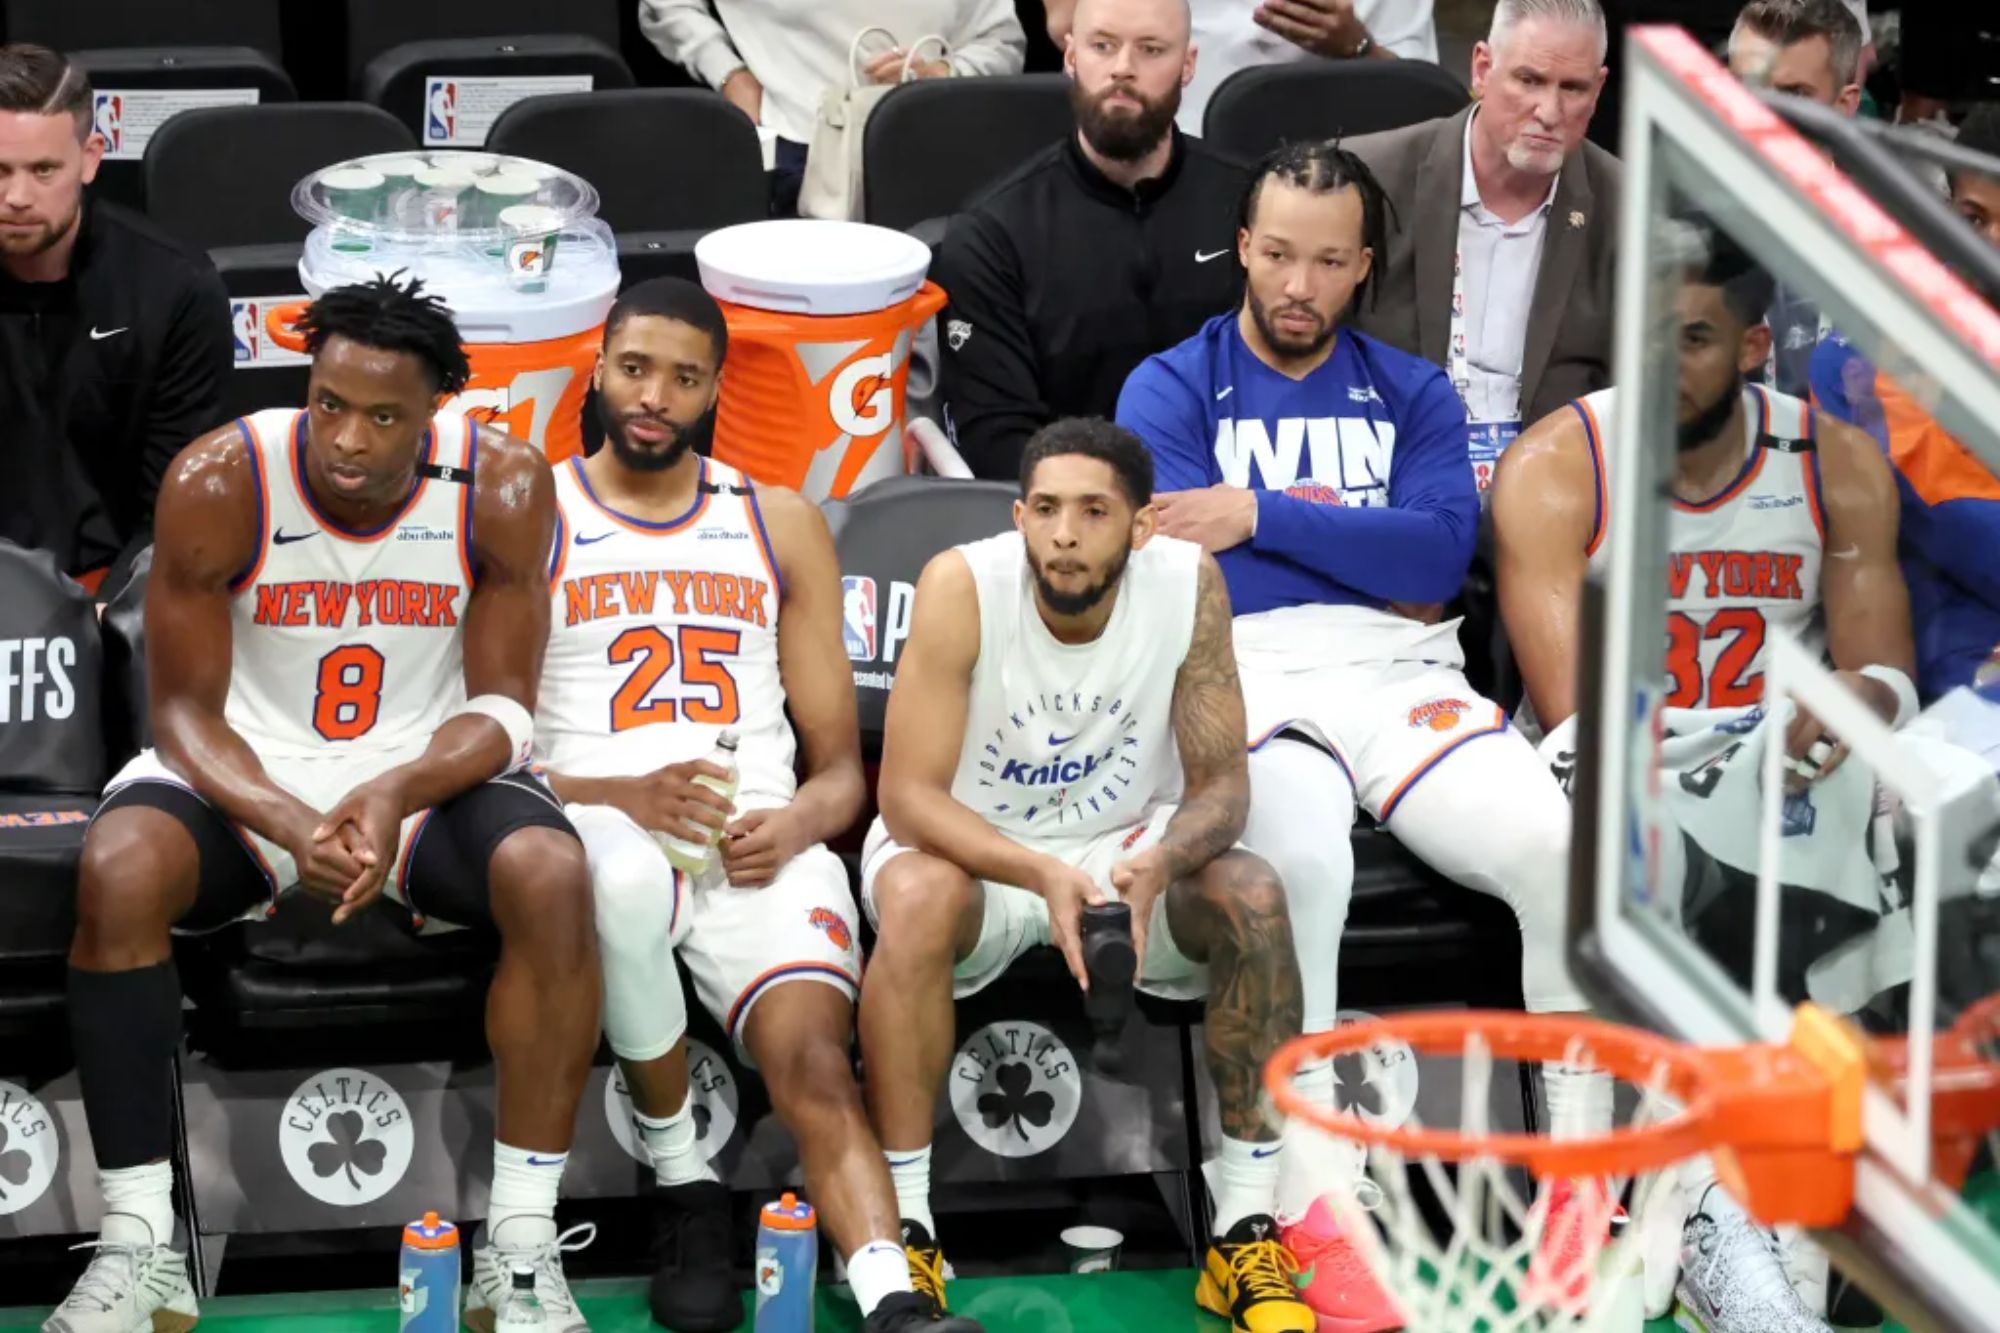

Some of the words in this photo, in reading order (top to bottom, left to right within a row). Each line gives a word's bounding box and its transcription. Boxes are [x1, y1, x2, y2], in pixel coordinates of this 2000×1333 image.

[829, 352, 892, 436] G
[1214, 417, 1396, 491] WIN
[254, 581, 353, 628] NEW
[355, 579, 460, 627] YORK
[564, 571, 658, 628] NEW
[662, 570, 768, 629] YORK
[1696, 551, 1803, 600] YORK
[607, 624, 741, 732] 25
[1665, 607, 1766, 709] 32
[312, 644, 386, 742] 8
[958, 1029, 1070, 1083] CELTICS
[288, 1076, 402, 1132] CELTICS
